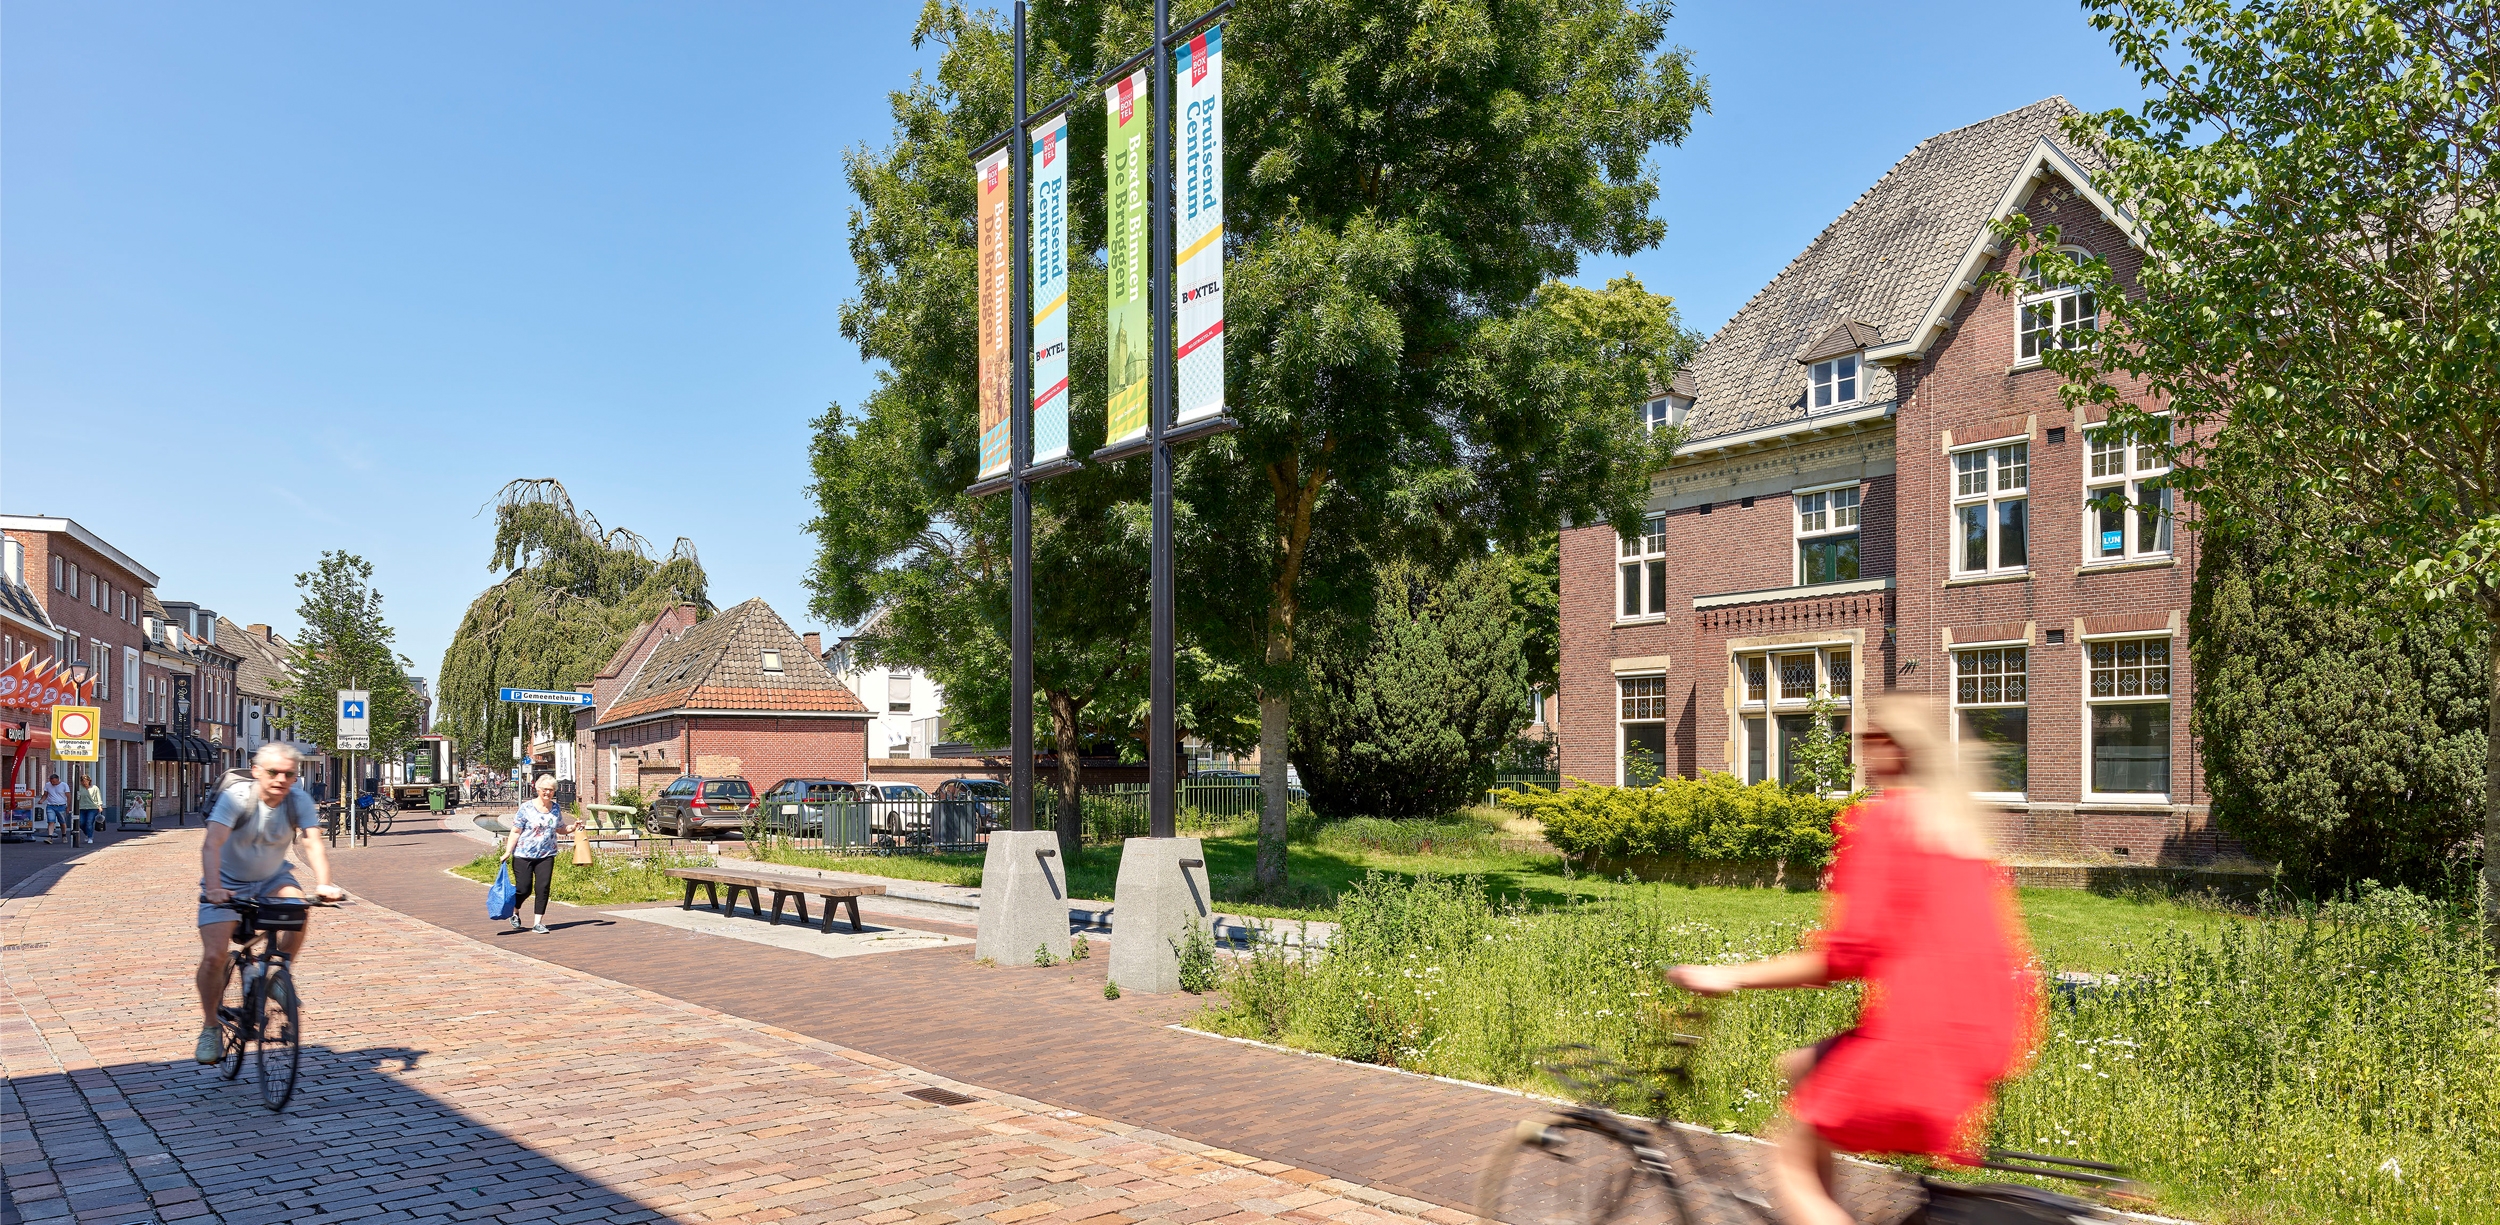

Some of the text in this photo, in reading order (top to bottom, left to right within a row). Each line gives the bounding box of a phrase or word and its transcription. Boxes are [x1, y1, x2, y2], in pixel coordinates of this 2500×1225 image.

[1192, 49, 1207, 61] beleef
[1193, 58, 1206, 70] BOX
[1193, 67, 1206, 78] TEL
[1120, 92, 1133, 103] beleef
[1120, 100, 1133, 111] BOX
[1121, 108, 1133, 118] TEL
[1044, 143, 1055, 153] BOX
[1202, 94, 1217, 212] Bruisend
[1044, 150, 1055, 161] TEL
[1187, 101, 1201, 221] Centrum
[988, 171, 998, 180] BOX
[988, 178, 998, 187] TEL
[1111, 149, 1127, 299] De Bruggen
[1129, 132, 1143, 304] Boxtel Binnen
[1039, 180, 1051, 288] Centrum
[1051, 175, 1063, 281] Bruisend
[982, 213, 994, 347] De Bruggen
[994, 199, 1006, 351] Boxtel Binnen
[523, 692, 576, 702] Gemeentehuis
[8, 728, 25, 742] expert
